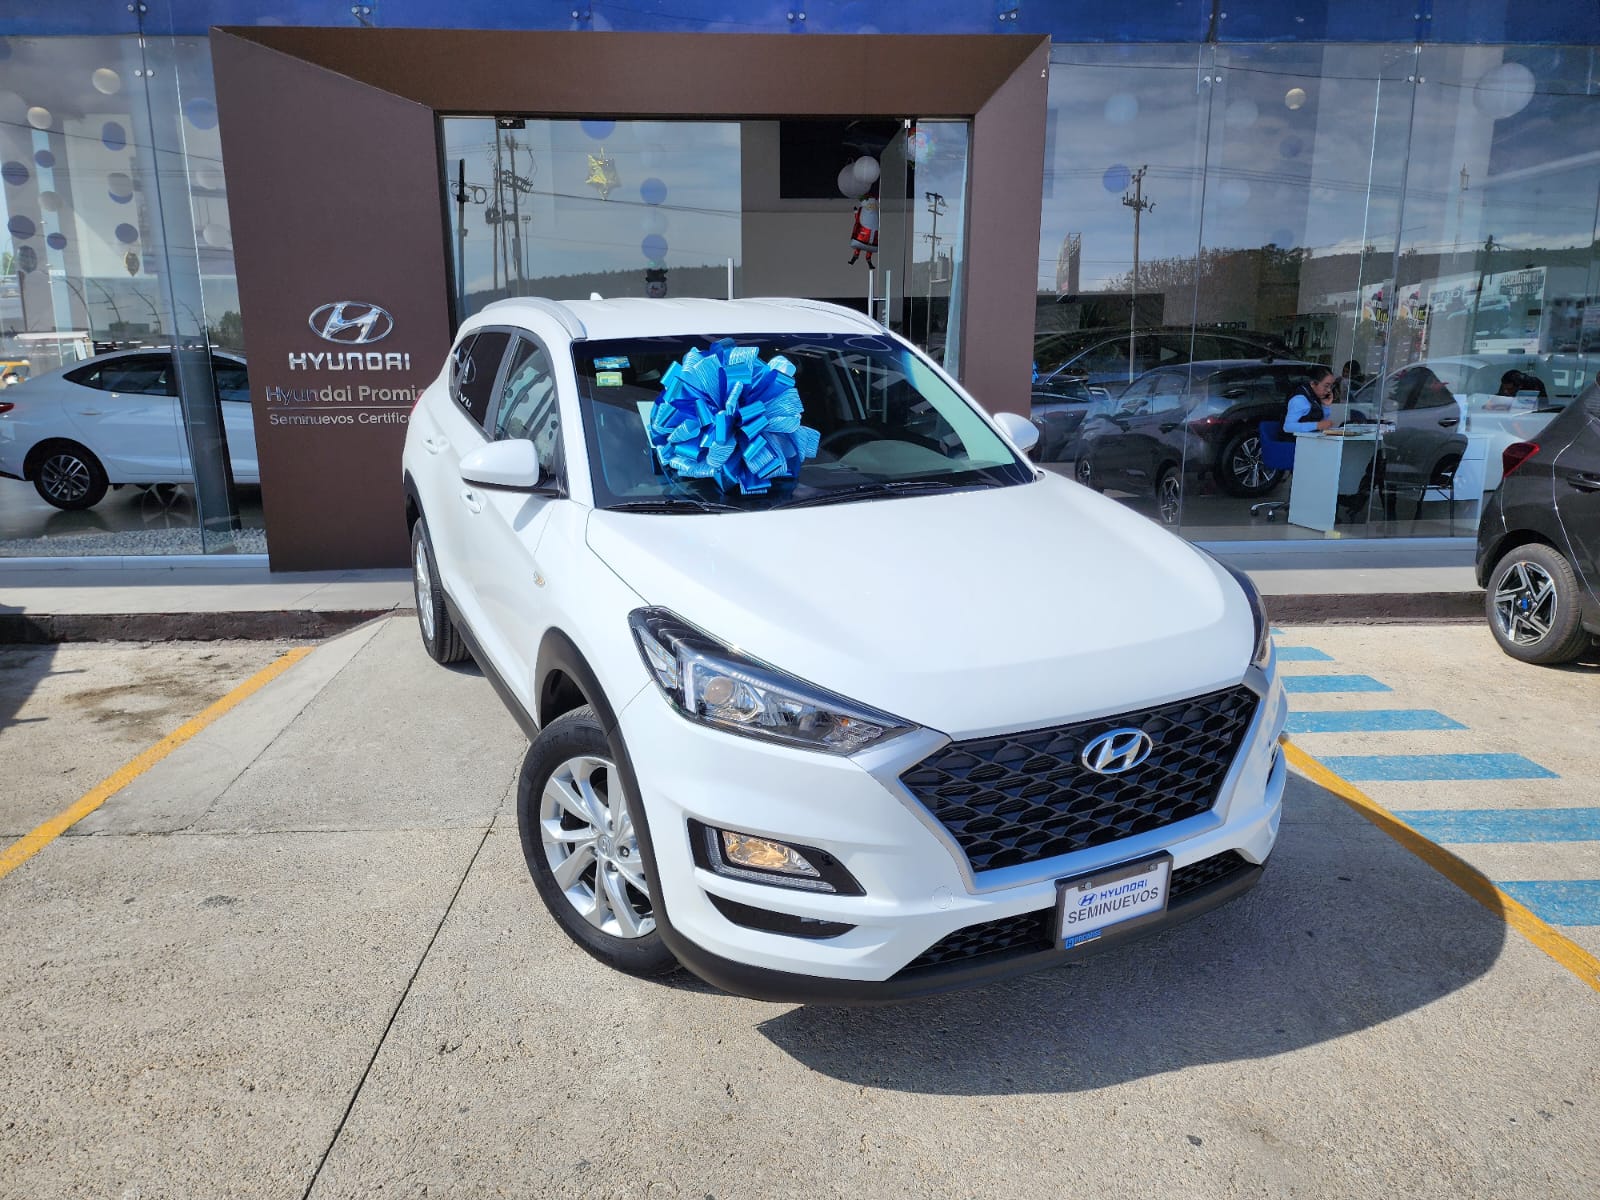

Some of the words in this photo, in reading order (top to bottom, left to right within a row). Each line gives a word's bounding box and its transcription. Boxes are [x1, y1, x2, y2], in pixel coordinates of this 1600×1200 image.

[288, 352, 411, 371] HYUNDAI
[265, 385, 352, 405] Hyundai
[269, 413, 354, 425] Seminuevos
[358, 411, 411, 425] Certific
[1100, 879, 1148, 901] HYUNDAI
[1067, 887, 1159, 924] SEMINUEVOS
